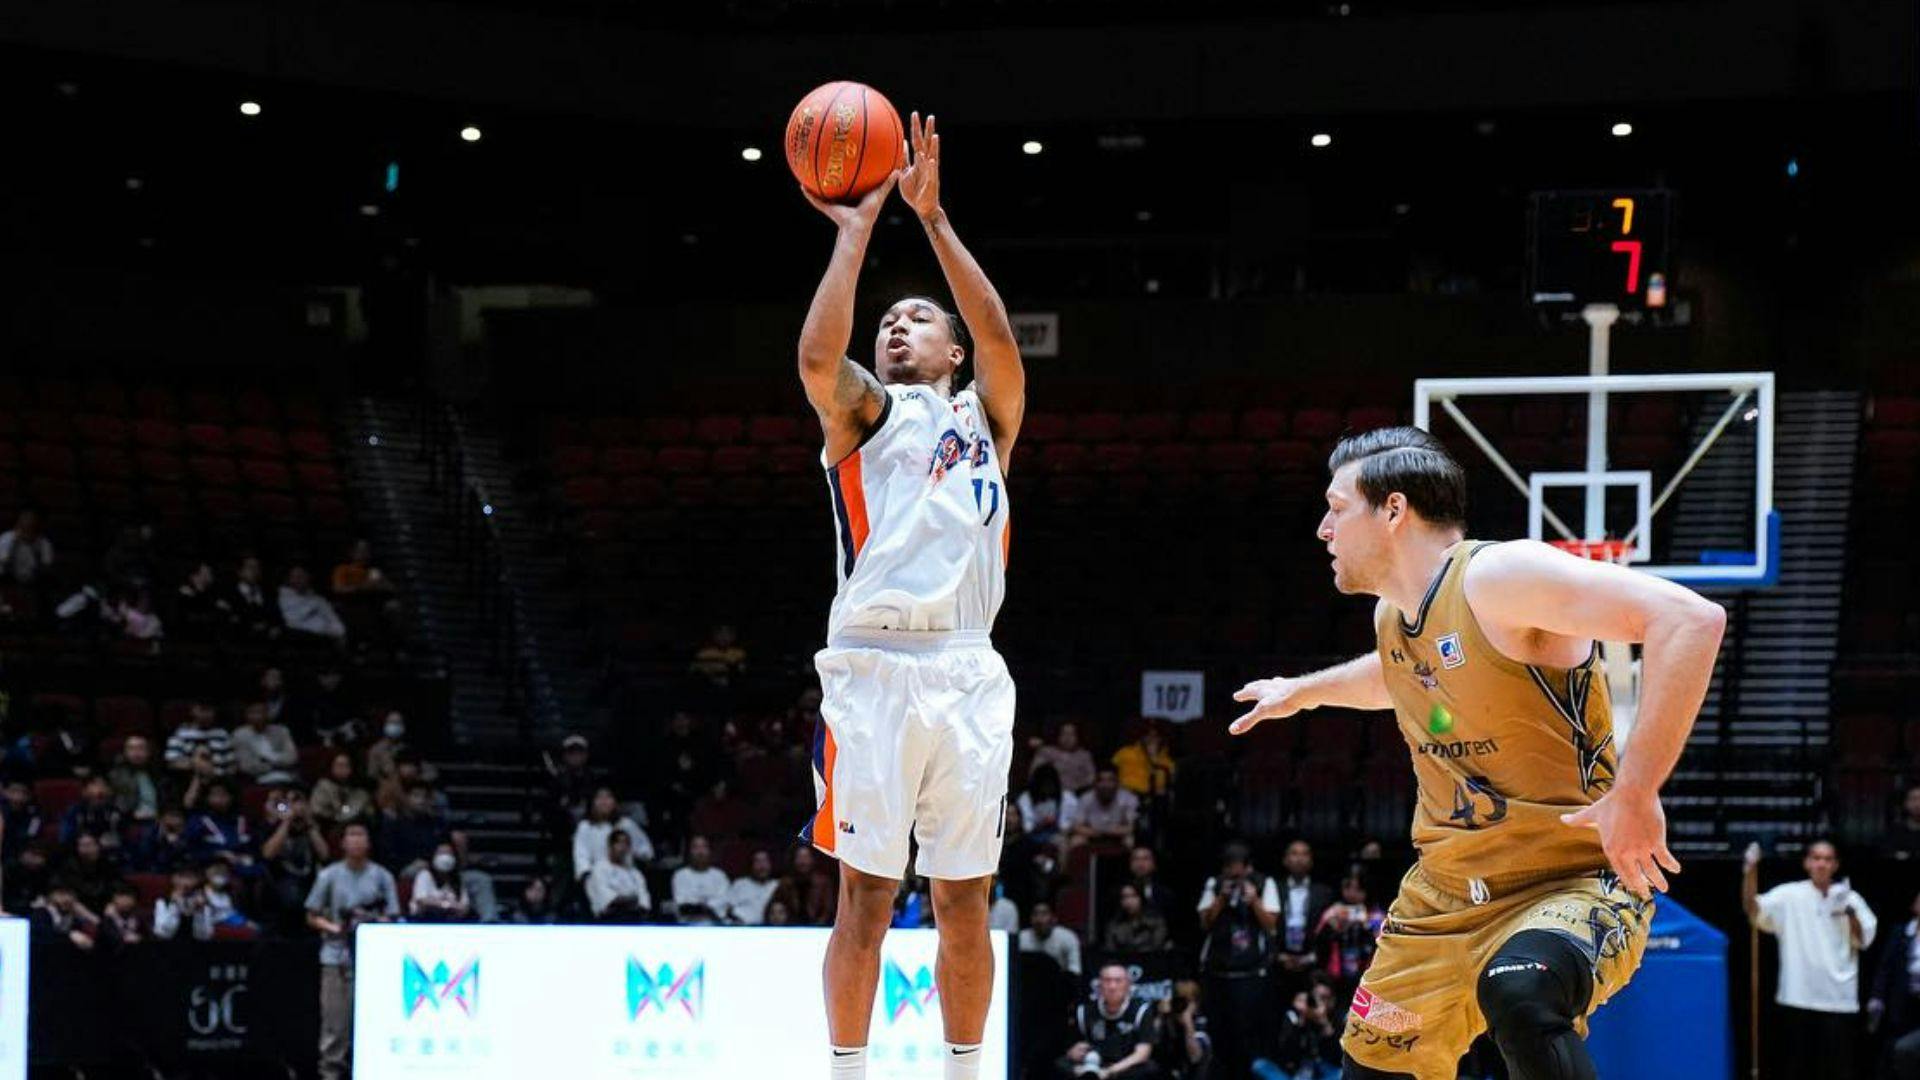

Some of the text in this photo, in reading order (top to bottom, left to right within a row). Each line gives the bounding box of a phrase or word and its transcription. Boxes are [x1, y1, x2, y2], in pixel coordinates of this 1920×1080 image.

[1612, 198, 1634, 235] 7
[1611, 241, 1642, 294] 7
[1155, 684, 1191, 711] 107
